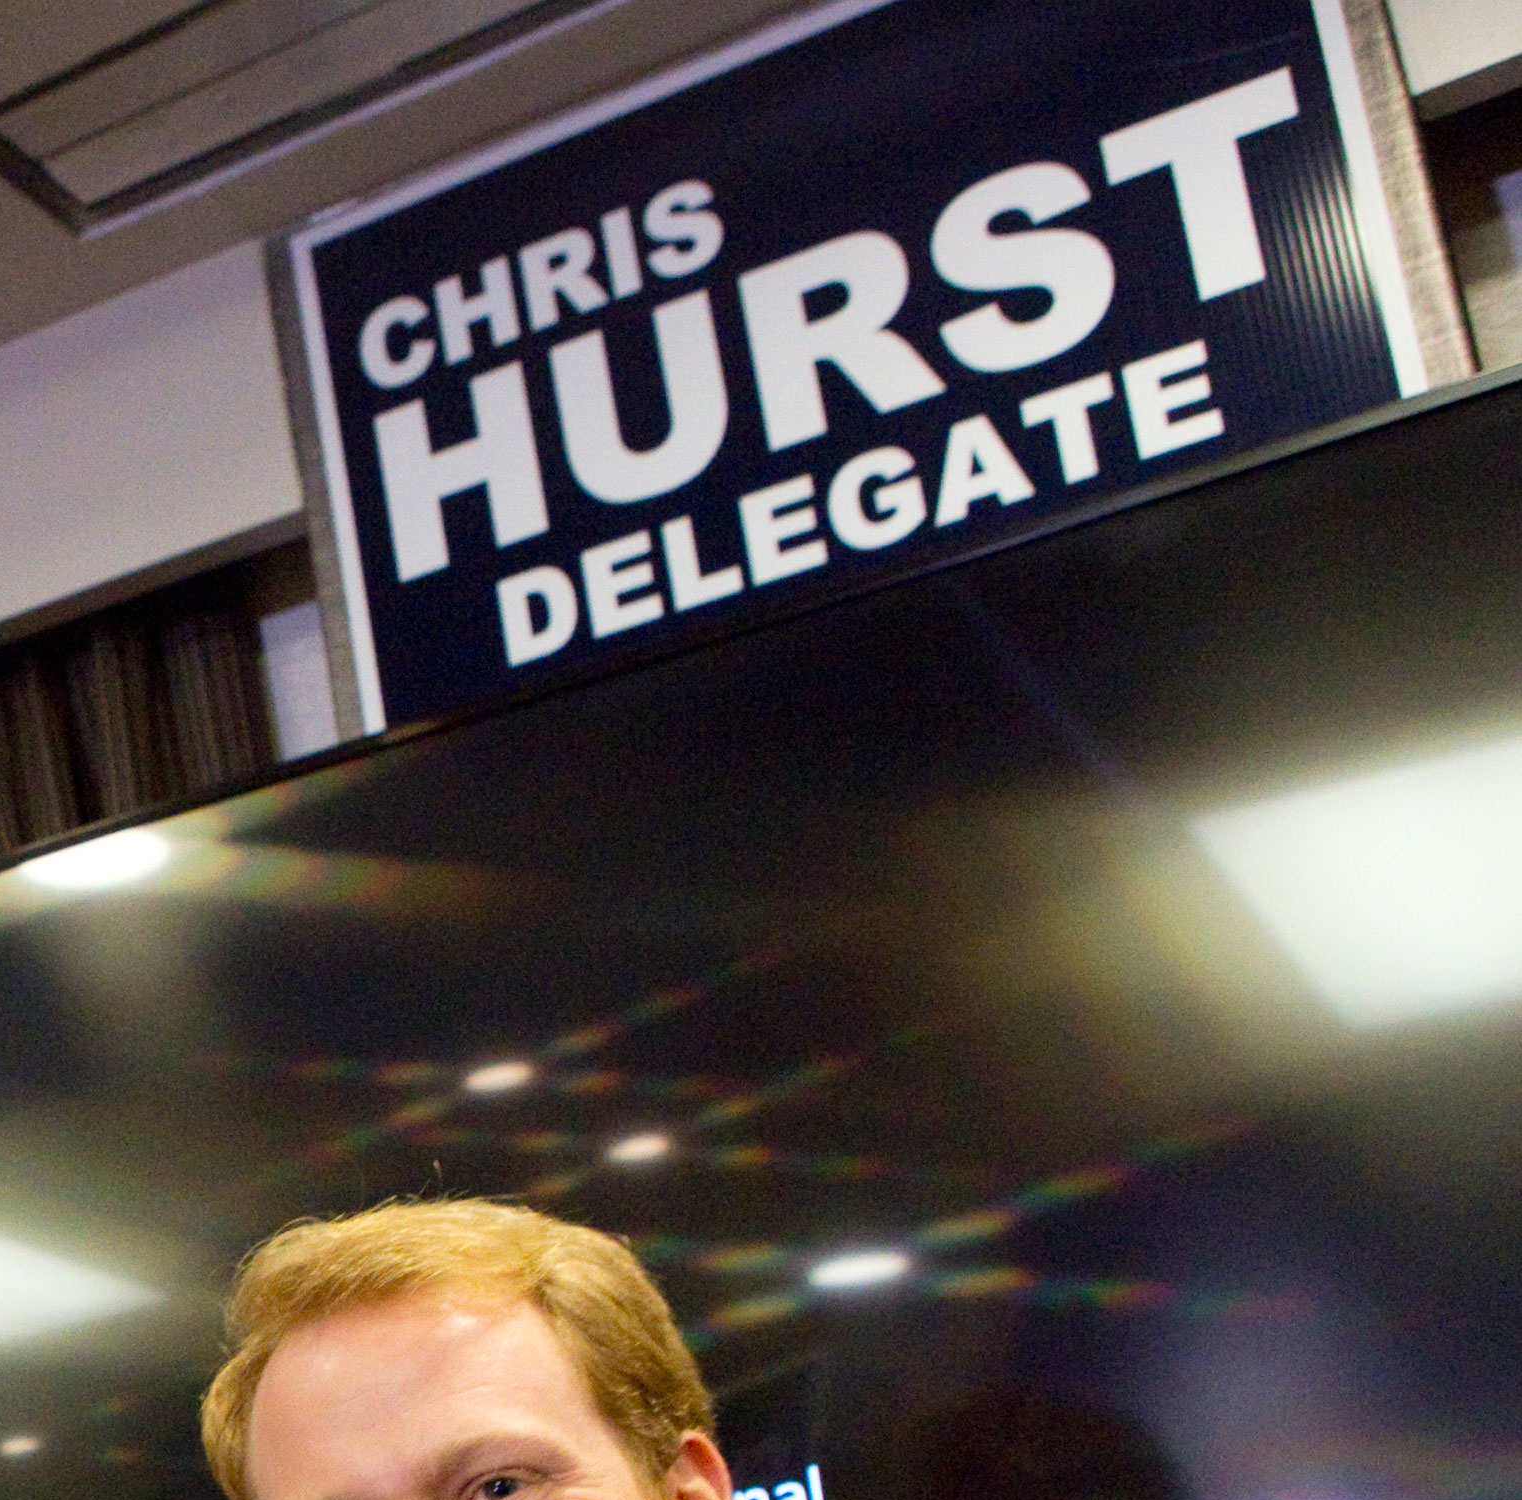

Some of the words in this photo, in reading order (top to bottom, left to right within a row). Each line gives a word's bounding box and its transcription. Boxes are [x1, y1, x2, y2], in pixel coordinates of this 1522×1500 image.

[360, 182, 723, 388] CHRIS
[373, 66, 1300, 583] HURST
[496, 340, 1225, 667] DELEGATE
